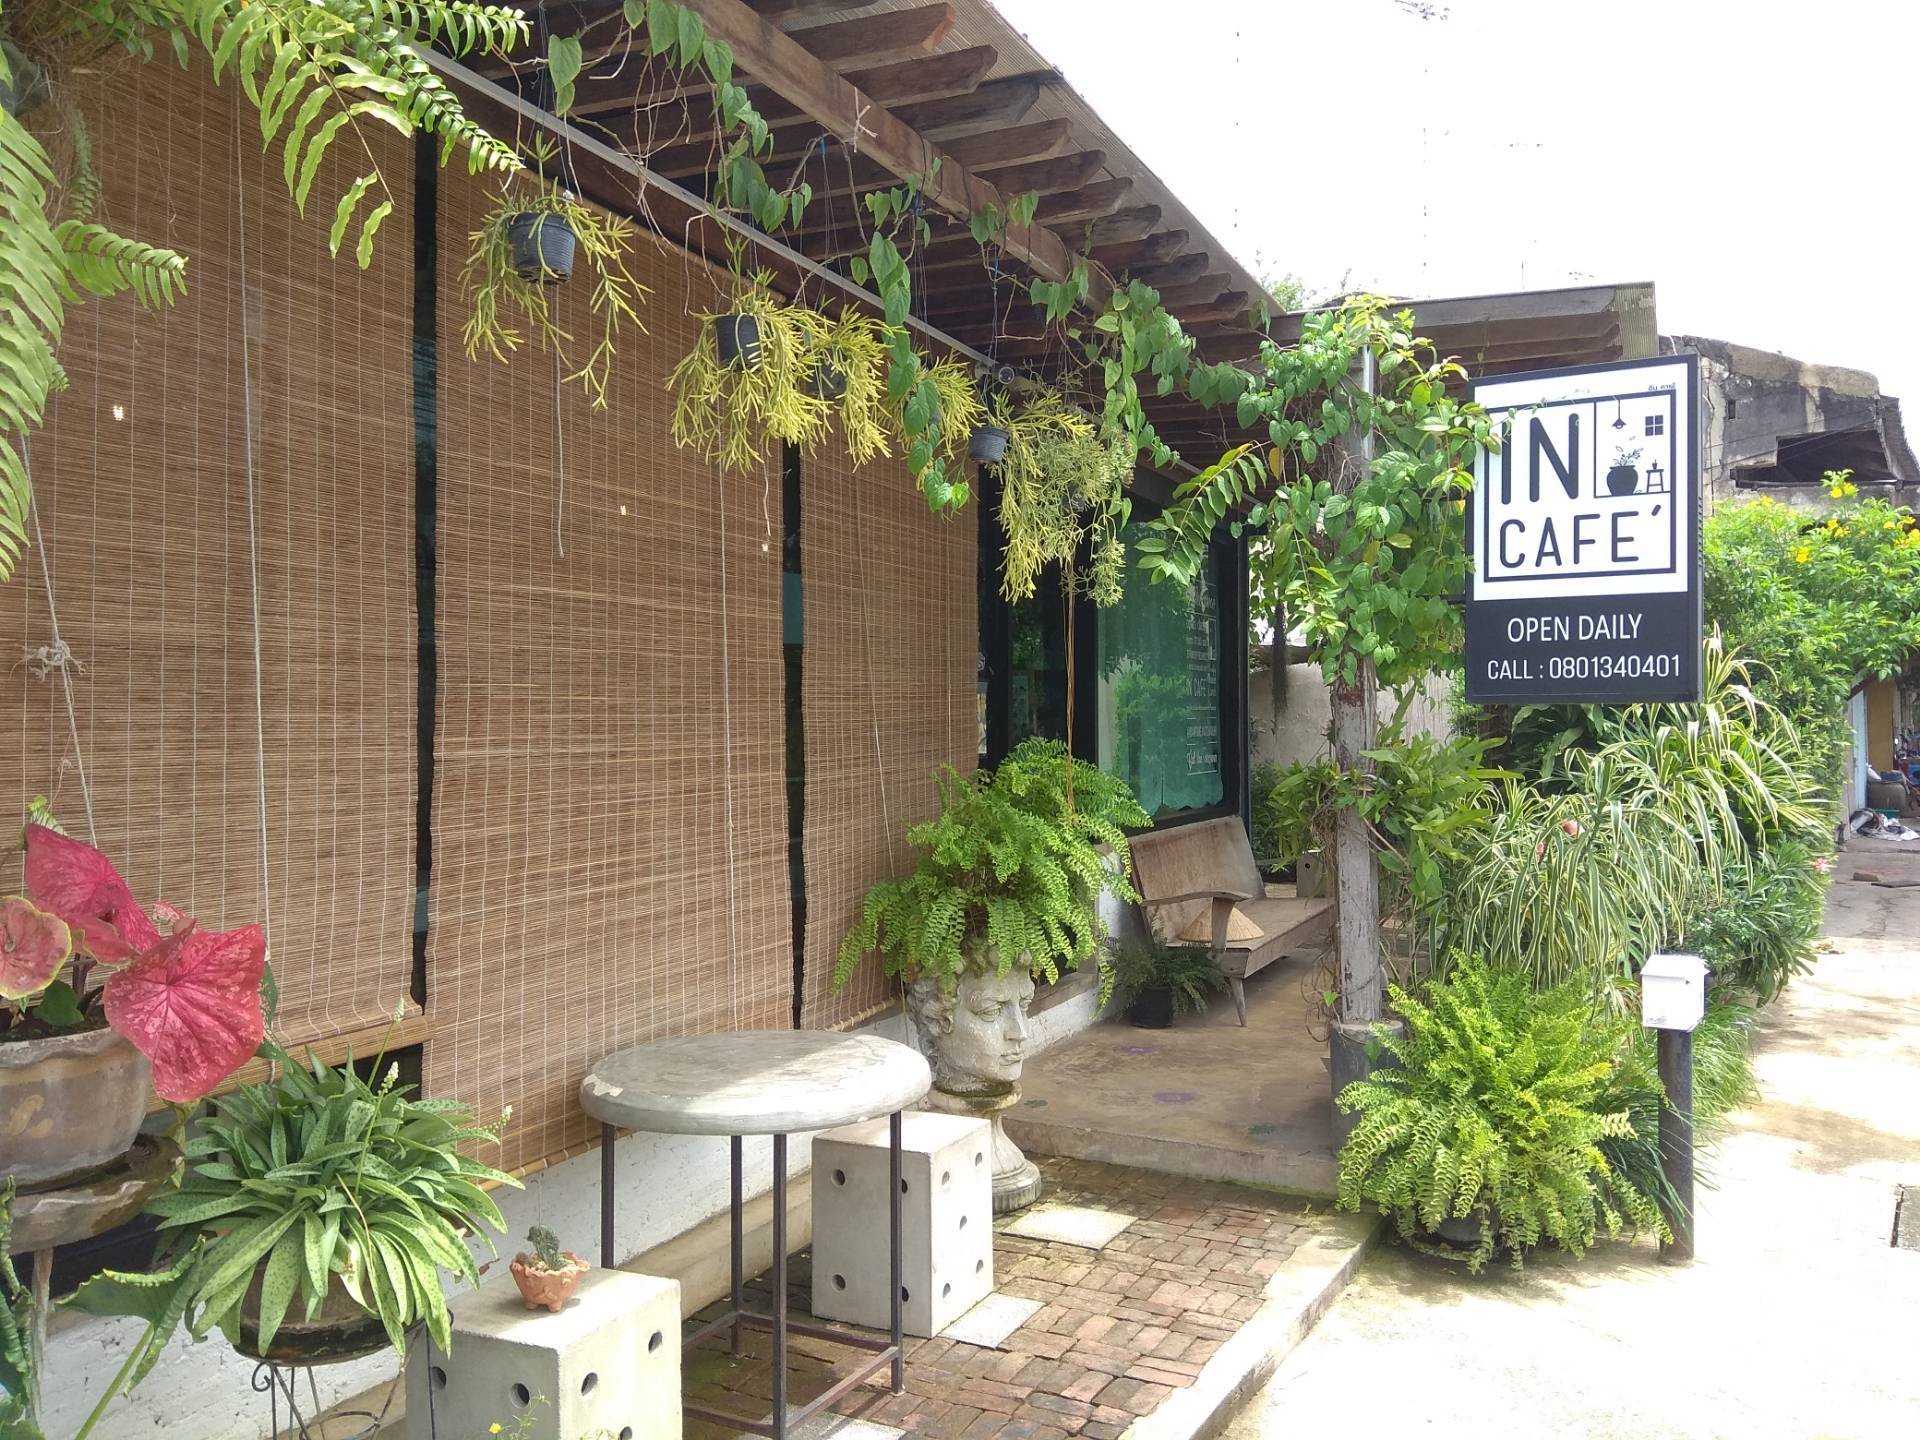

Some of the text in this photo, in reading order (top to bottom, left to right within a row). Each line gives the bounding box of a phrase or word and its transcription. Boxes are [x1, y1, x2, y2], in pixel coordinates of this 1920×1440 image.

[1501, 413, 1580, 505] IN
[1507, 613, 1643, 643] OPEN DAILY
[1487, 659, 1533, 680] CALL
[1549, 654, 1680, 679] 0801340401
